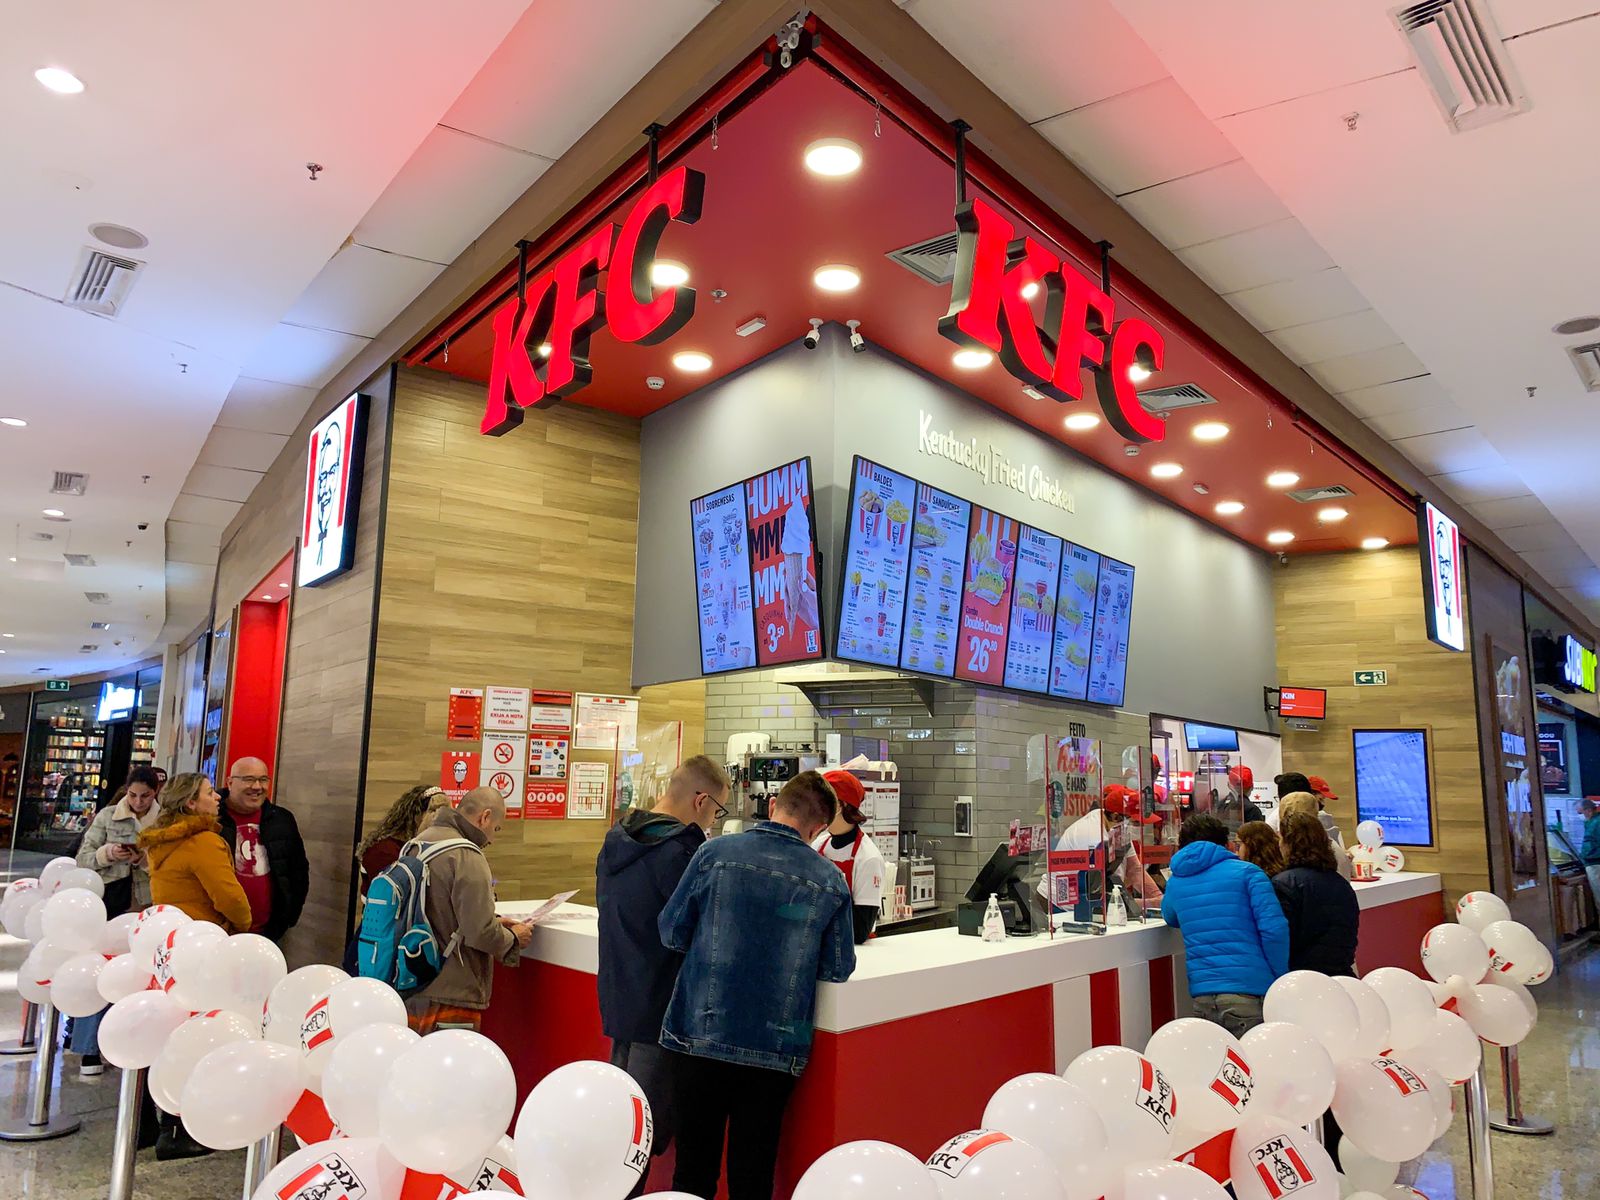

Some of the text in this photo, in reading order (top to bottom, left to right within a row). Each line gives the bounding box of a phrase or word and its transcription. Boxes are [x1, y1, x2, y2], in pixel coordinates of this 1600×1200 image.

[480, 166, 692, 436] KFC
[953, 197, 1166, 443] KFC
[918, 409, 1076, 514] Kentucky Fried Chicken
[873, 472, 893, 488] BALDES
[1069, 722, 1086, 738] FEITO
[1071, 777, 1087, 792] MAIS
[1143, 1095, 1171, 1126] KFC
[927, 1152, 959, 1170] KFC
[1255, 1138, 1285, 1161] KFC
[326, 1159, 360, 1193] KFC
